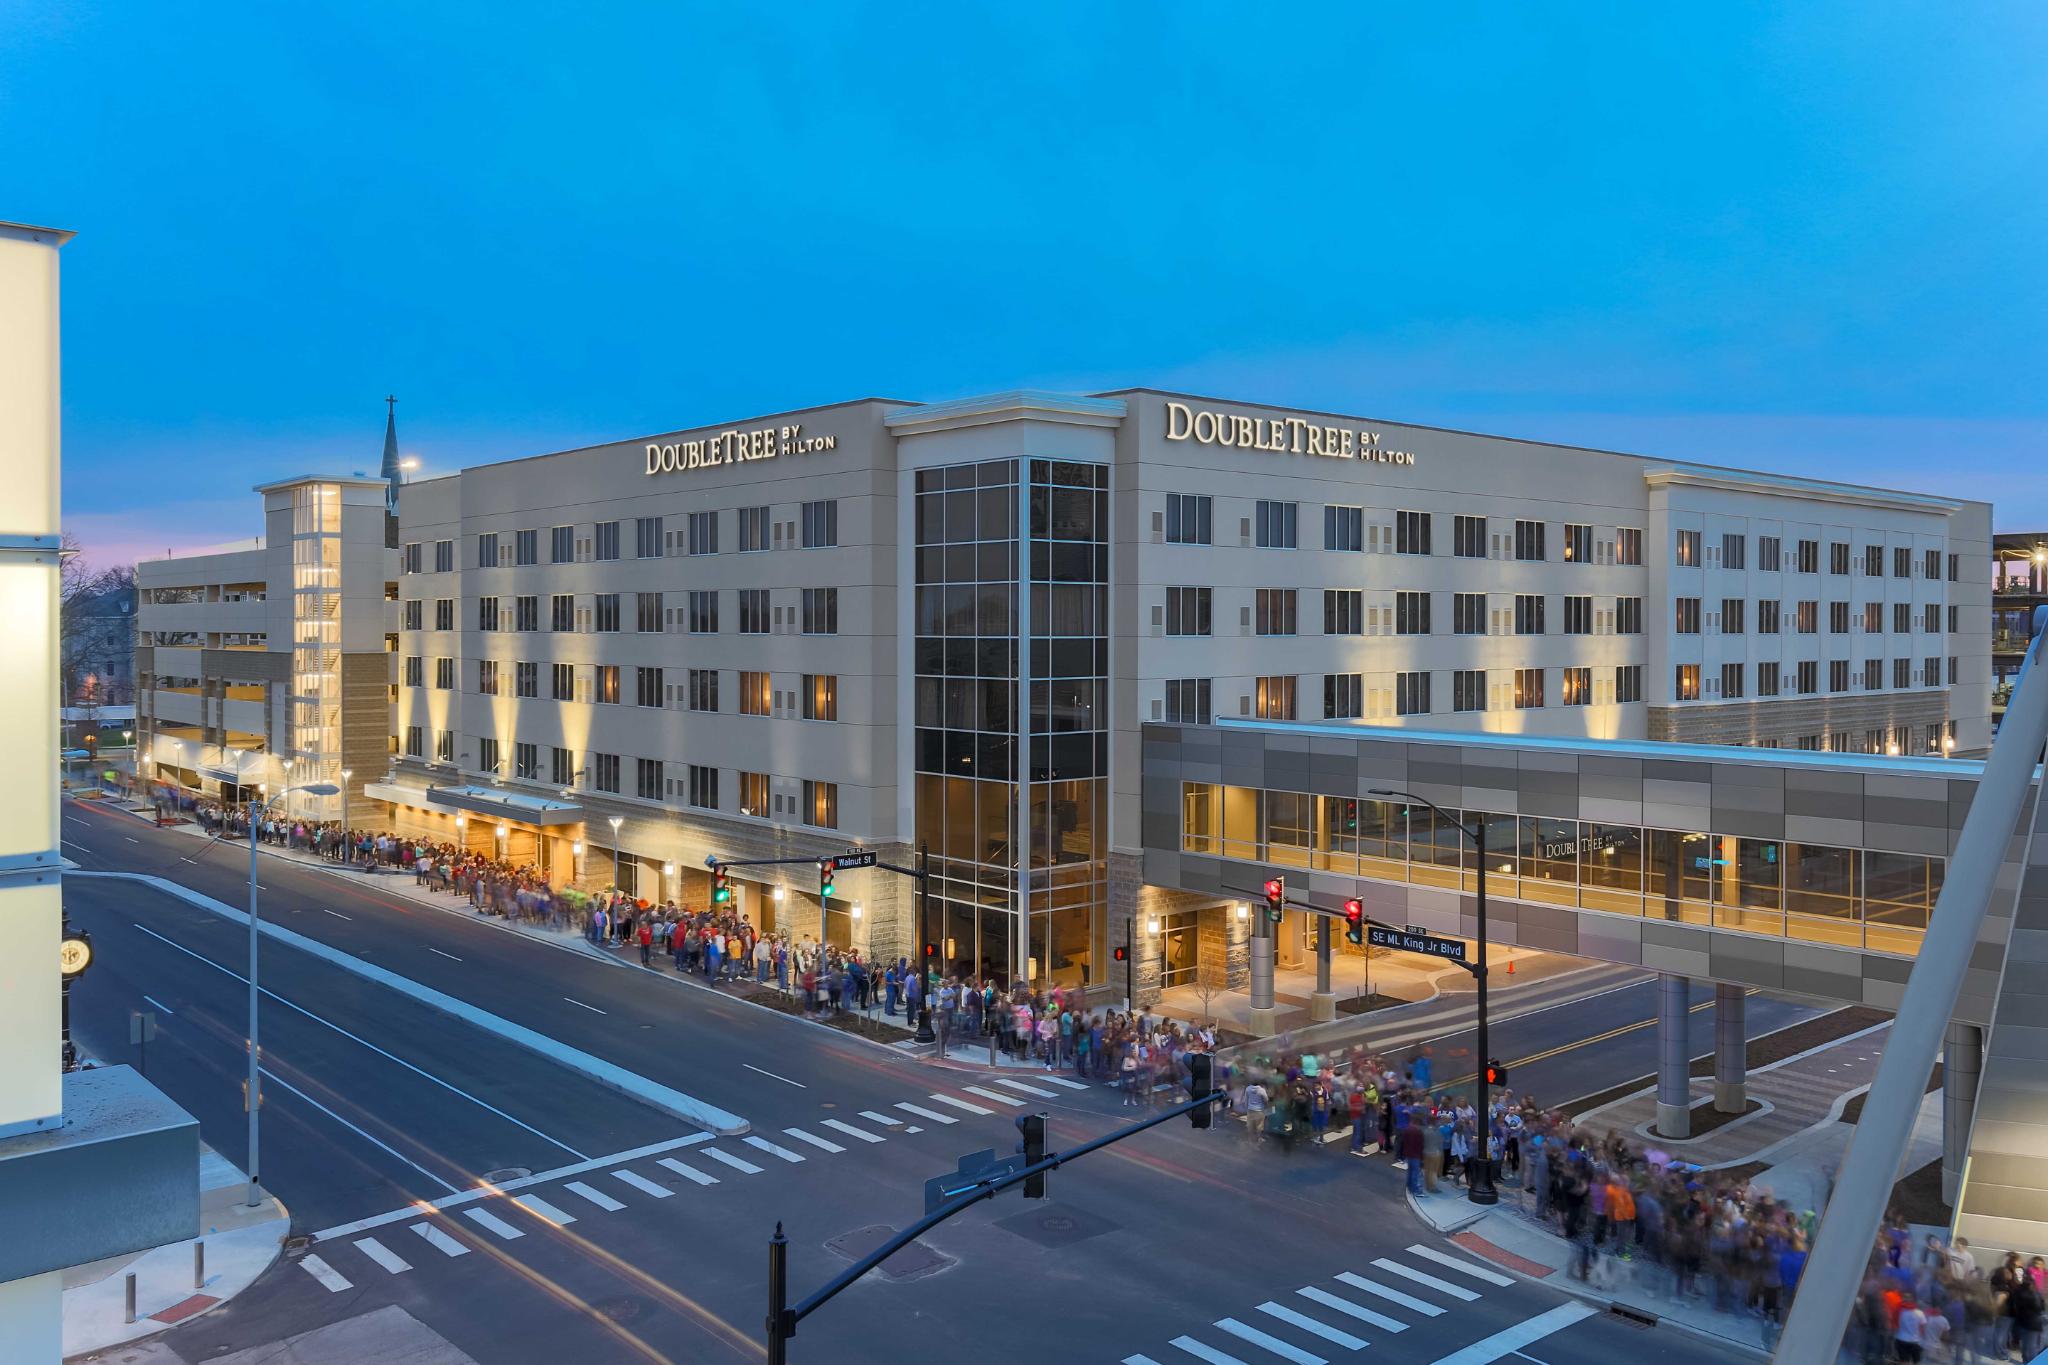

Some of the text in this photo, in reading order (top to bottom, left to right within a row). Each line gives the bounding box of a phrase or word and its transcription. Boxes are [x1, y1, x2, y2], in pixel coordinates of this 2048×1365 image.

[1166, 402, 1380, 458] DOUBLETREE BY
[645, 424, 800, 475] DOUBLETREE BY
[782, 435, 835, 455] HILTON
[1360, 448, 1415, 465] HILTON
[1546, 837, 1604, 858] DOUBLTREE
[838, 855, 871, 867] Walnut St
[1372, 931, 1461, 956] SE ML King Jr Blvd
